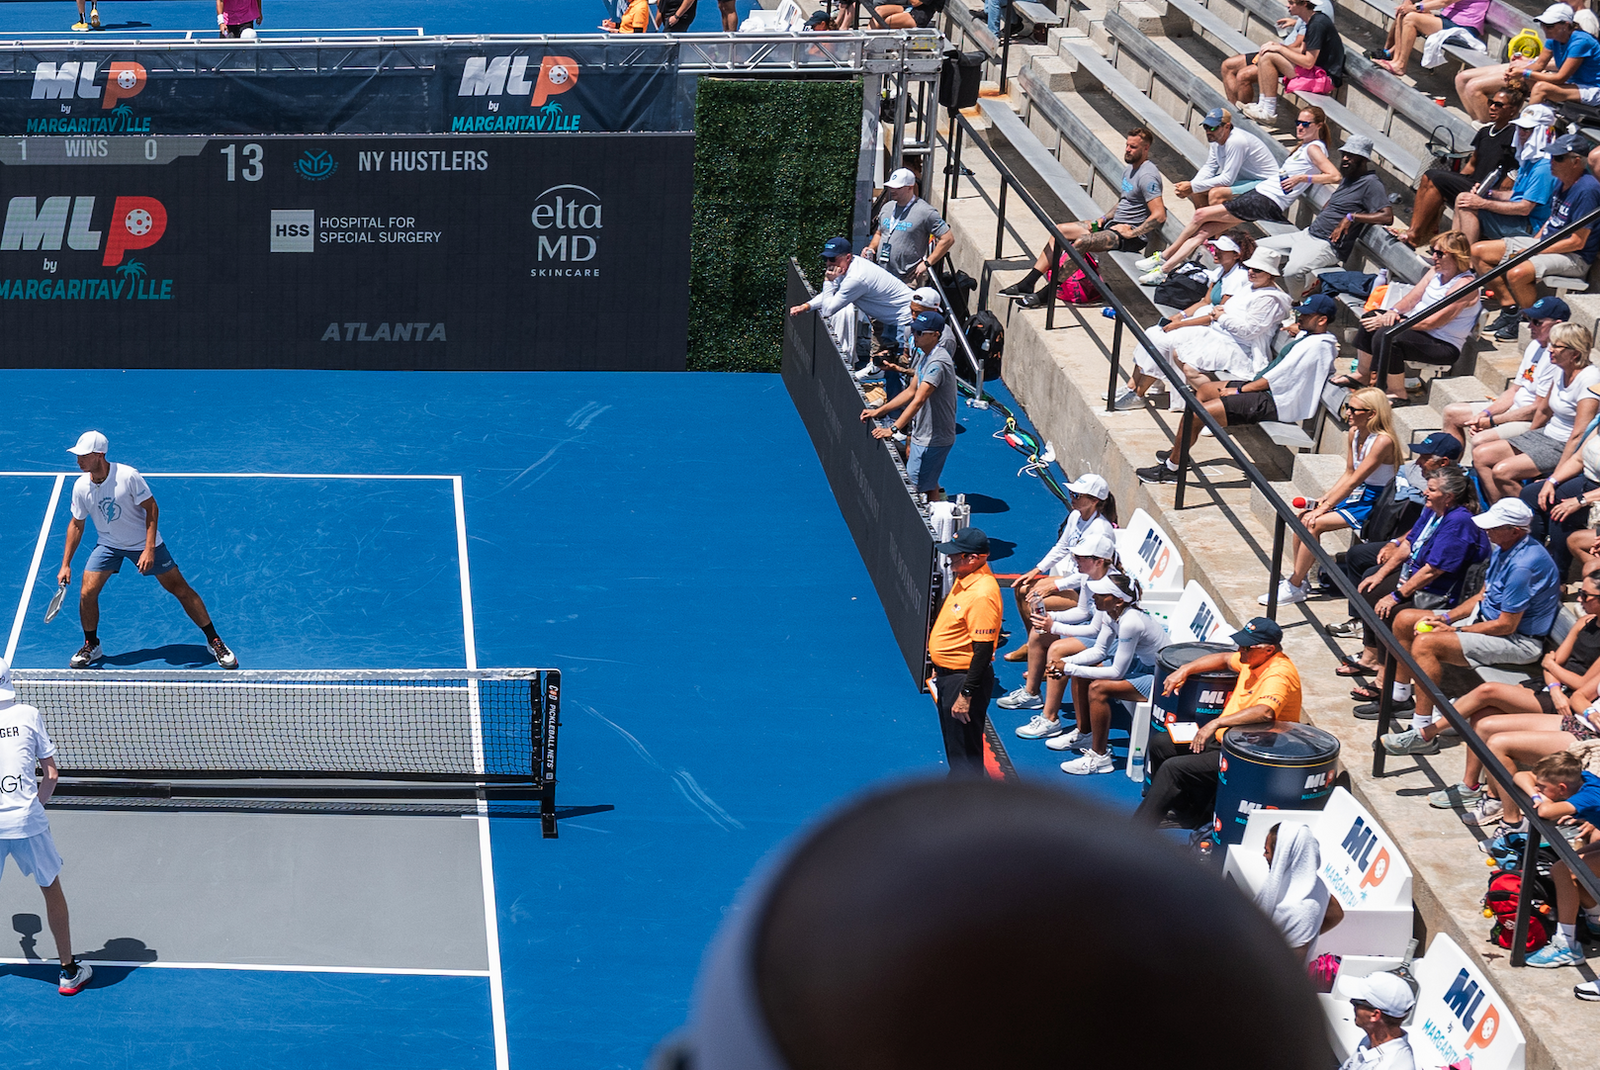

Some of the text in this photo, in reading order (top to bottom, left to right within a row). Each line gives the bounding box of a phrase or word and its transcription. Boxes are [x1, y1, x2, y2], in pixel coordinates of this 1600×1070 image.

[31, 61, 148, 109] MLP
[458, 56, 580, 107] MLP
[60, 104, 71, 114] by
[488, 101, 499, 112] by
[17, 139, 158, 160] 1 WINS 0
[220, 143, 264, 181] 13
[358, 150, 489, 171] NY HUSTLERS
[320, 217, 415, 228] HOSPITAL FOR
[531, 195, 604, 229] elta
[0, 196, 168, 266] MLP
[276, 224, 310, 237] HSS
[319, 232, 442, 243] SPECIAL SURGERY
[537, 235, 597, 262] MD
[43, 258, 57, 273] by
[530, 269, 600, 277] SKINCARE
[321, 322, 447, 342] ATLANTA
[1138, 528, 1170, 582] MLP
[1189, 601, 1220, 642] ML
[548, 703, 556, 748] PICKLEBALL
[546, 748, 554, 769] NETS
[1341, 815, 1390, 889] MLP
[1323, 862, 1359, 907] MARGARITAV
[1442, 967, 1500, 1051] MLP
